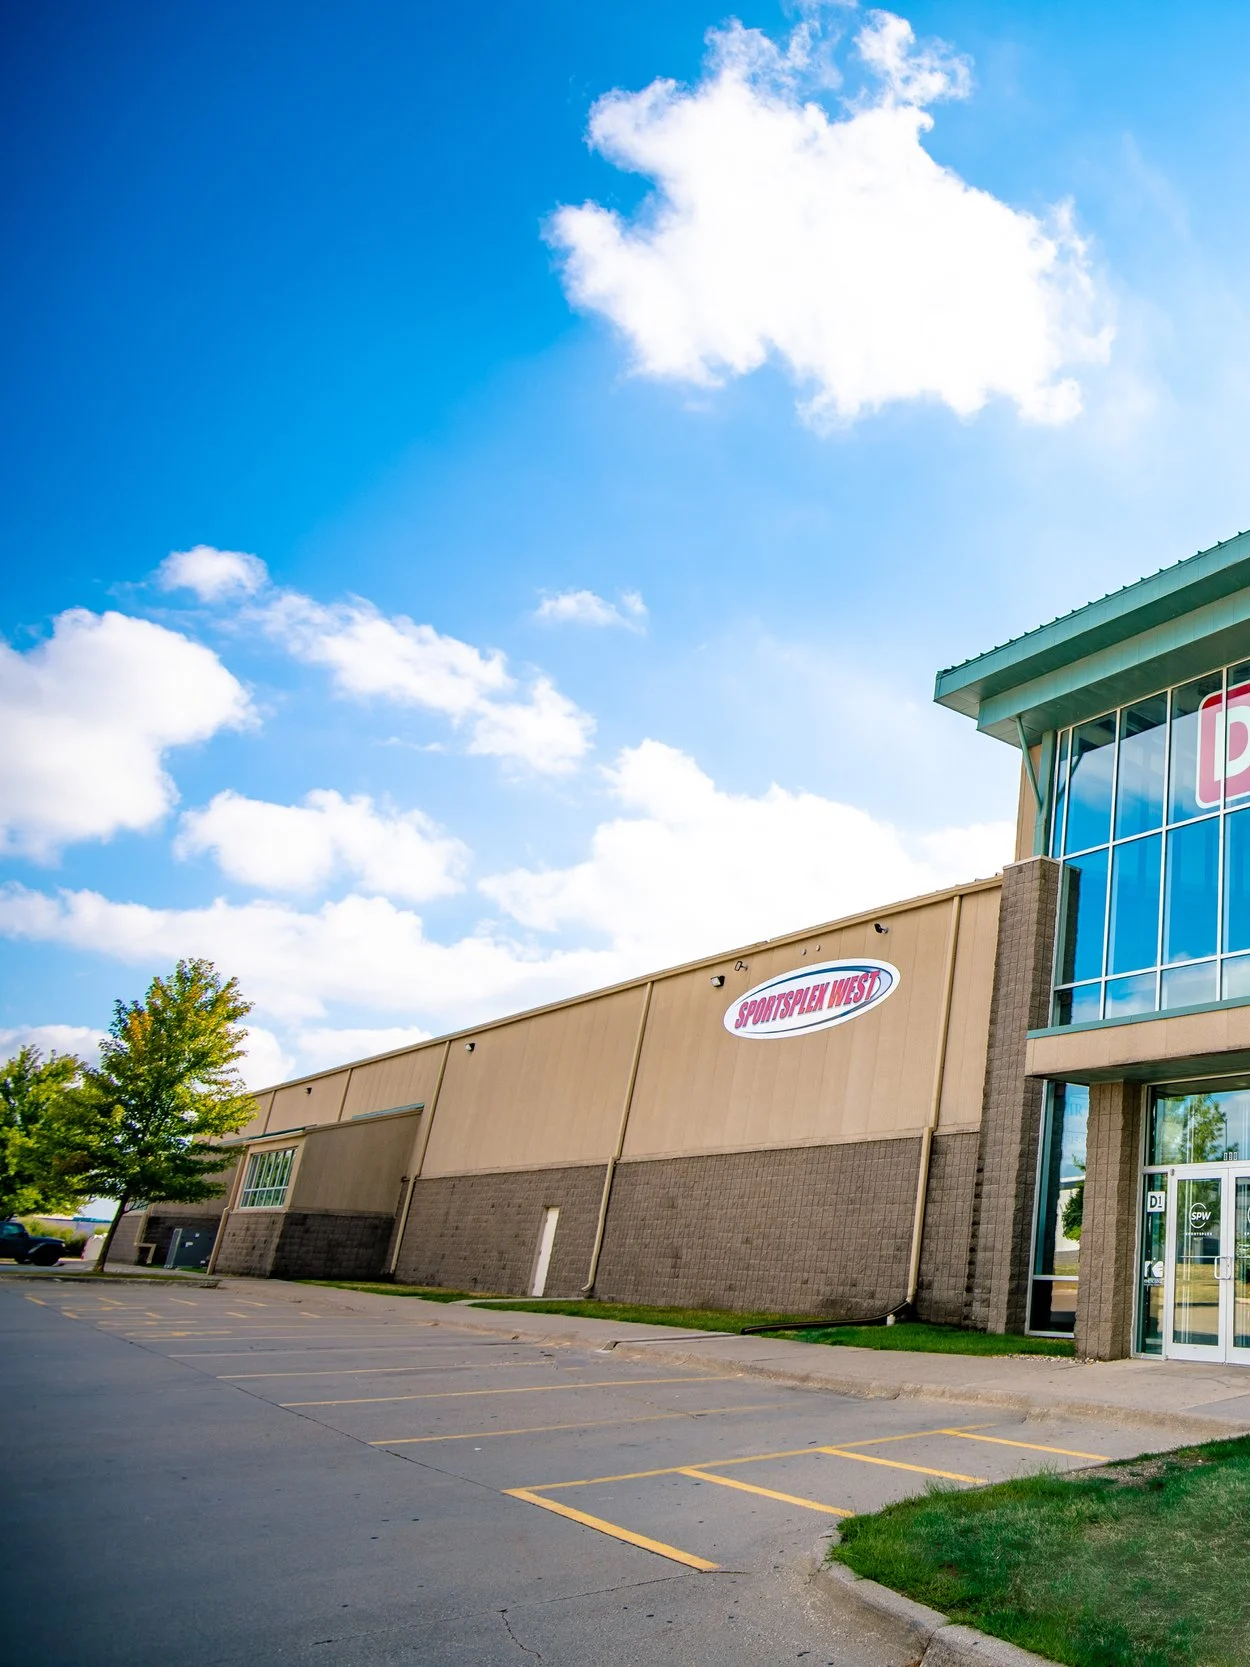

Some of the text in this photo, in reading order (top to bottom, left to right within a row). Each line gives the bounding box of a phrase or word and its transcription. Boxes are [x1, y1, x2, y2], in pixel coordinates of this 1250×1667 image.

[735, 971, 880, 1029] SPORTSPLEX WEST
[1149, 1195, 1163, 1209] D1
[1191, 1211, 1211, 1221] SPW
